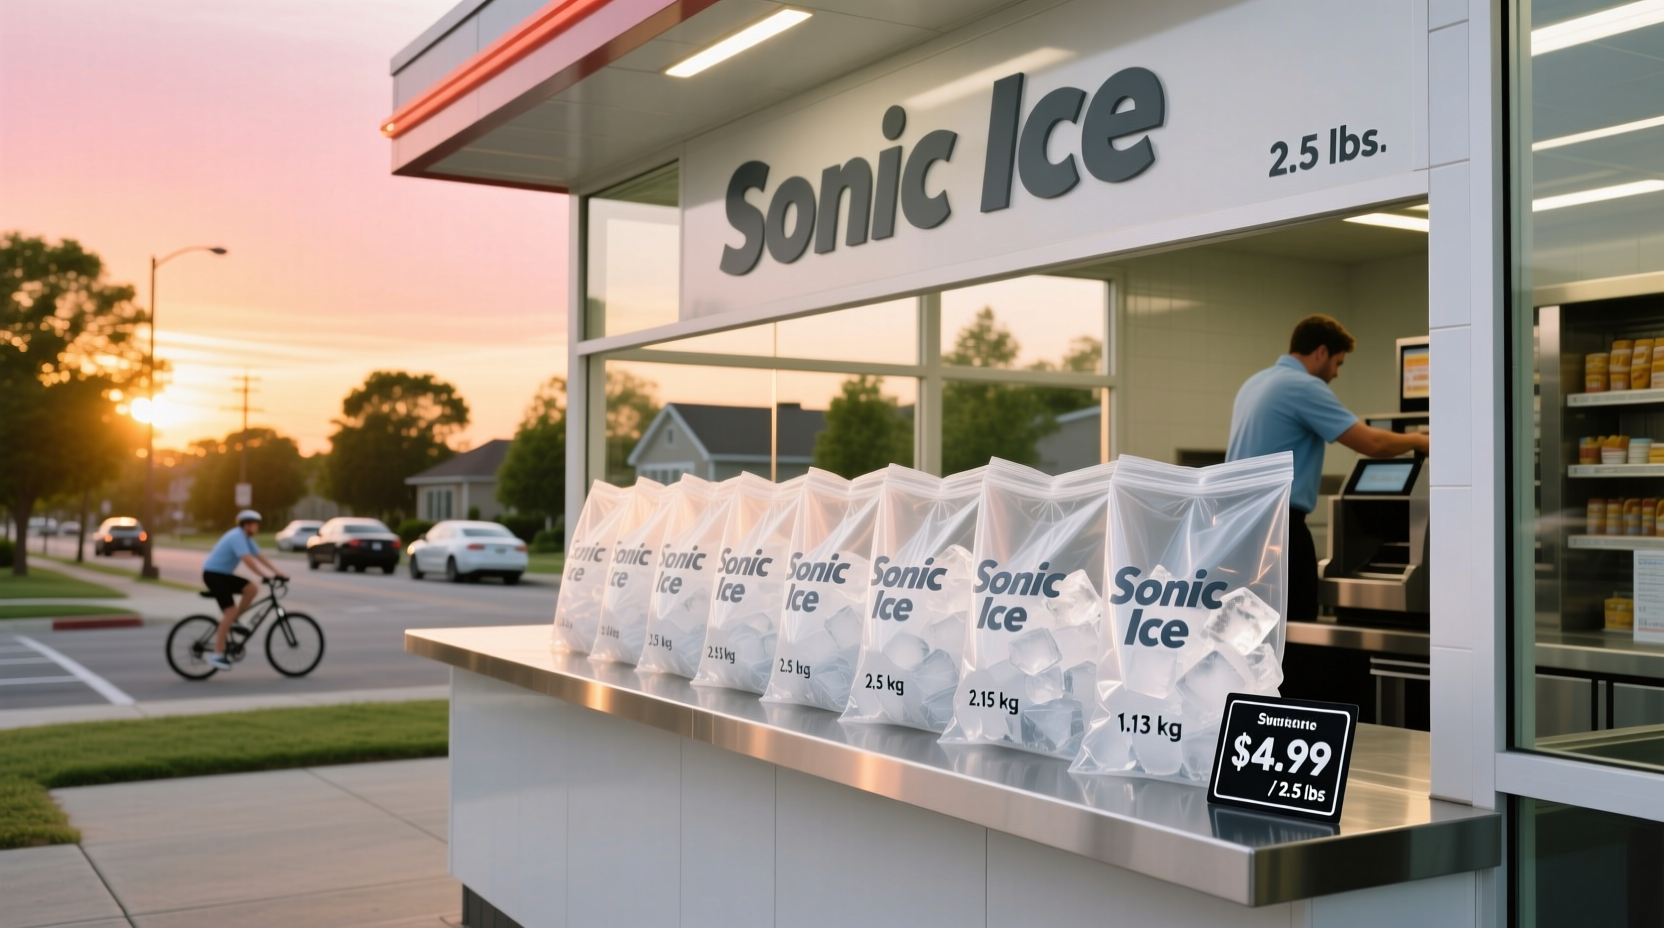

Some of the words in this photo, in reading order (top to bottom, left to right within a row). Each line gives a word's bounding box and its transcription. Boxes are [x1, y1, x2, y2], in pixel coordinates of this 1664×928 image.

[1268, 133, 1319, 178] 2.5
[1329, 124, 1387, 165] lbs.
[720, 104, 958, 276] Sonic
[980, 66, 1166, 213] Ice
[613, 540, 653, 566] Sonic
[659, 543, 707, 571] Sonic
[717, 547, 773, 577] Sonic
[786, 552, 851, 584] Sonic
[656, 571, 683, 594] Ice
[871, 556, 948, 591] Sonic
[973, 559, 1068, 598] Sonic
[1110, 566, 1228, 610] Sonic
[716, 577, 745, 603] Ice
[785, 583, 819, 612] Ice
[871, 590, 913, 622] Ice
[976, 597, 1027, 632] Ice
[1124, 609, 1189, 648] Ice
[780, 658, 793, 674] 2.5
[865, 673, 883, 690] 2.5
[887, 675, 905, 695] kg
[969, 689, 995, 708] 2.15
[999, 692, 1019, 715] kg
[1117, 712, 1151, 735] 1.13
[1157, 715, 1182, 742] kg
[1231, 732, 1332, 777] $4.99
[1278, 781, 1302, 799] 2.5
[1304, 784, 1326, 802] lbs
